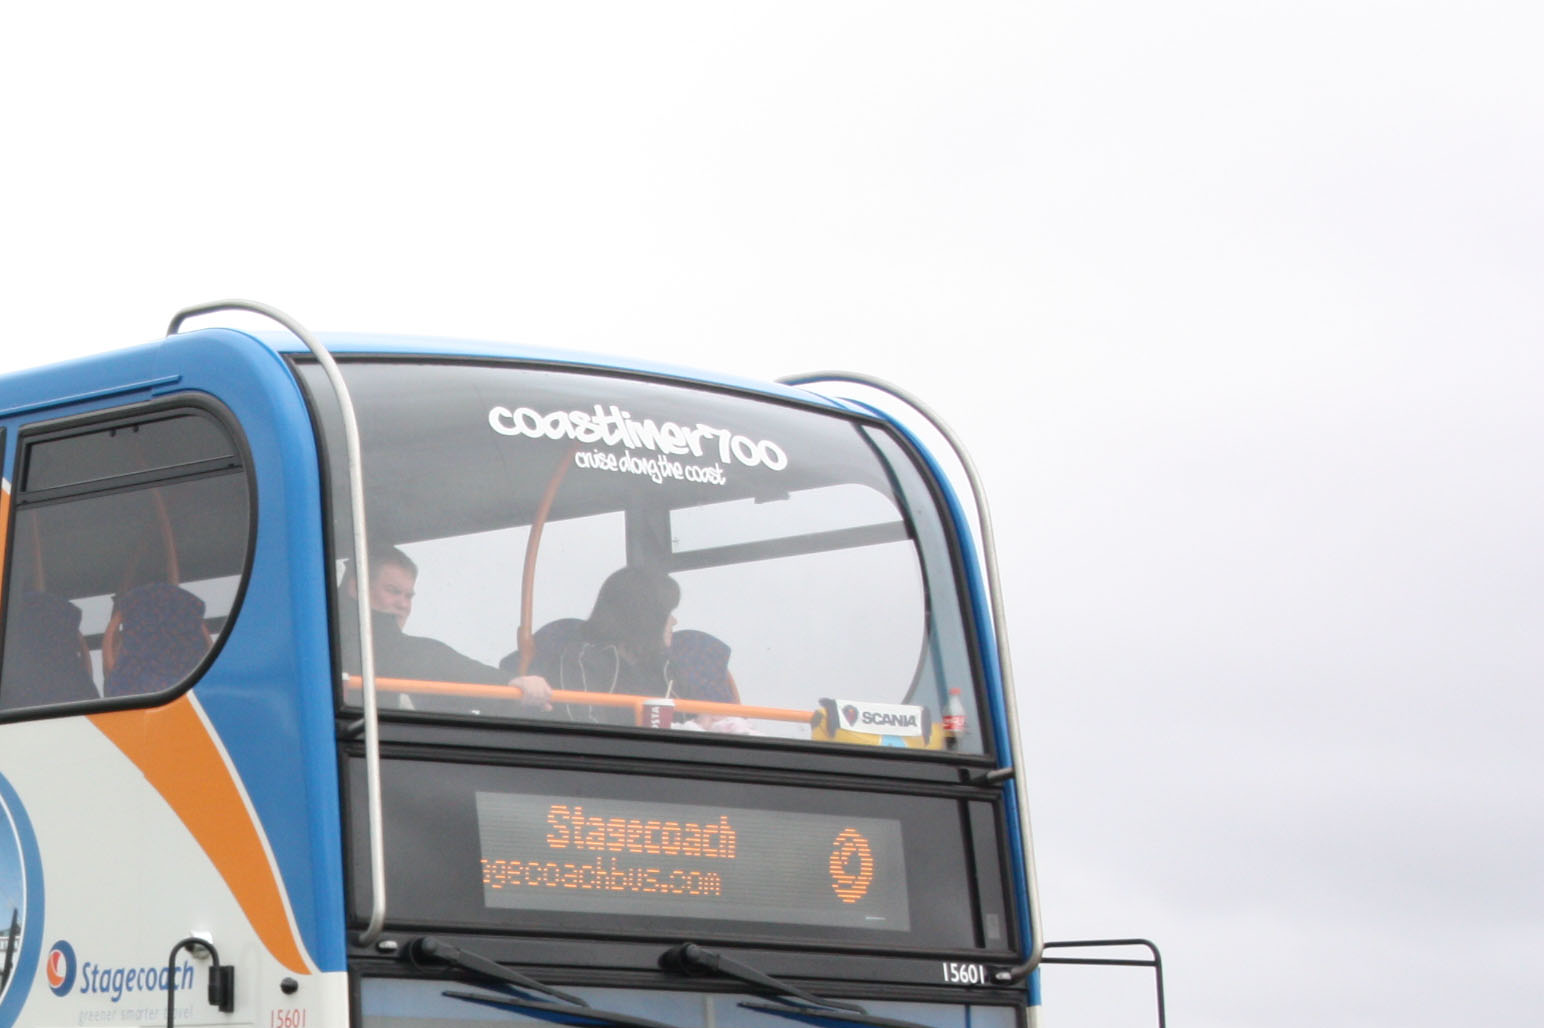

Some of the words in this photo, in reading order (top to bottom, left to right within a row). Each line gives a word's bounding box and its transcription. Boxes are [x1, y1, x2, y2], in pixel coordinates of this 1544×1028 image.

[575, 449, 617, 472] cruise
[619, 451, 663, 484] along
[657, 455, 684, 480] the
[685, 462, 727, 486] coast
[862, 711, 919, 728] SCANIA
[546, 804, 736, 859] Stagecoach
[80, 961, 194, 1002] Stagecoach
[942, 962, 985, 985] 15601
